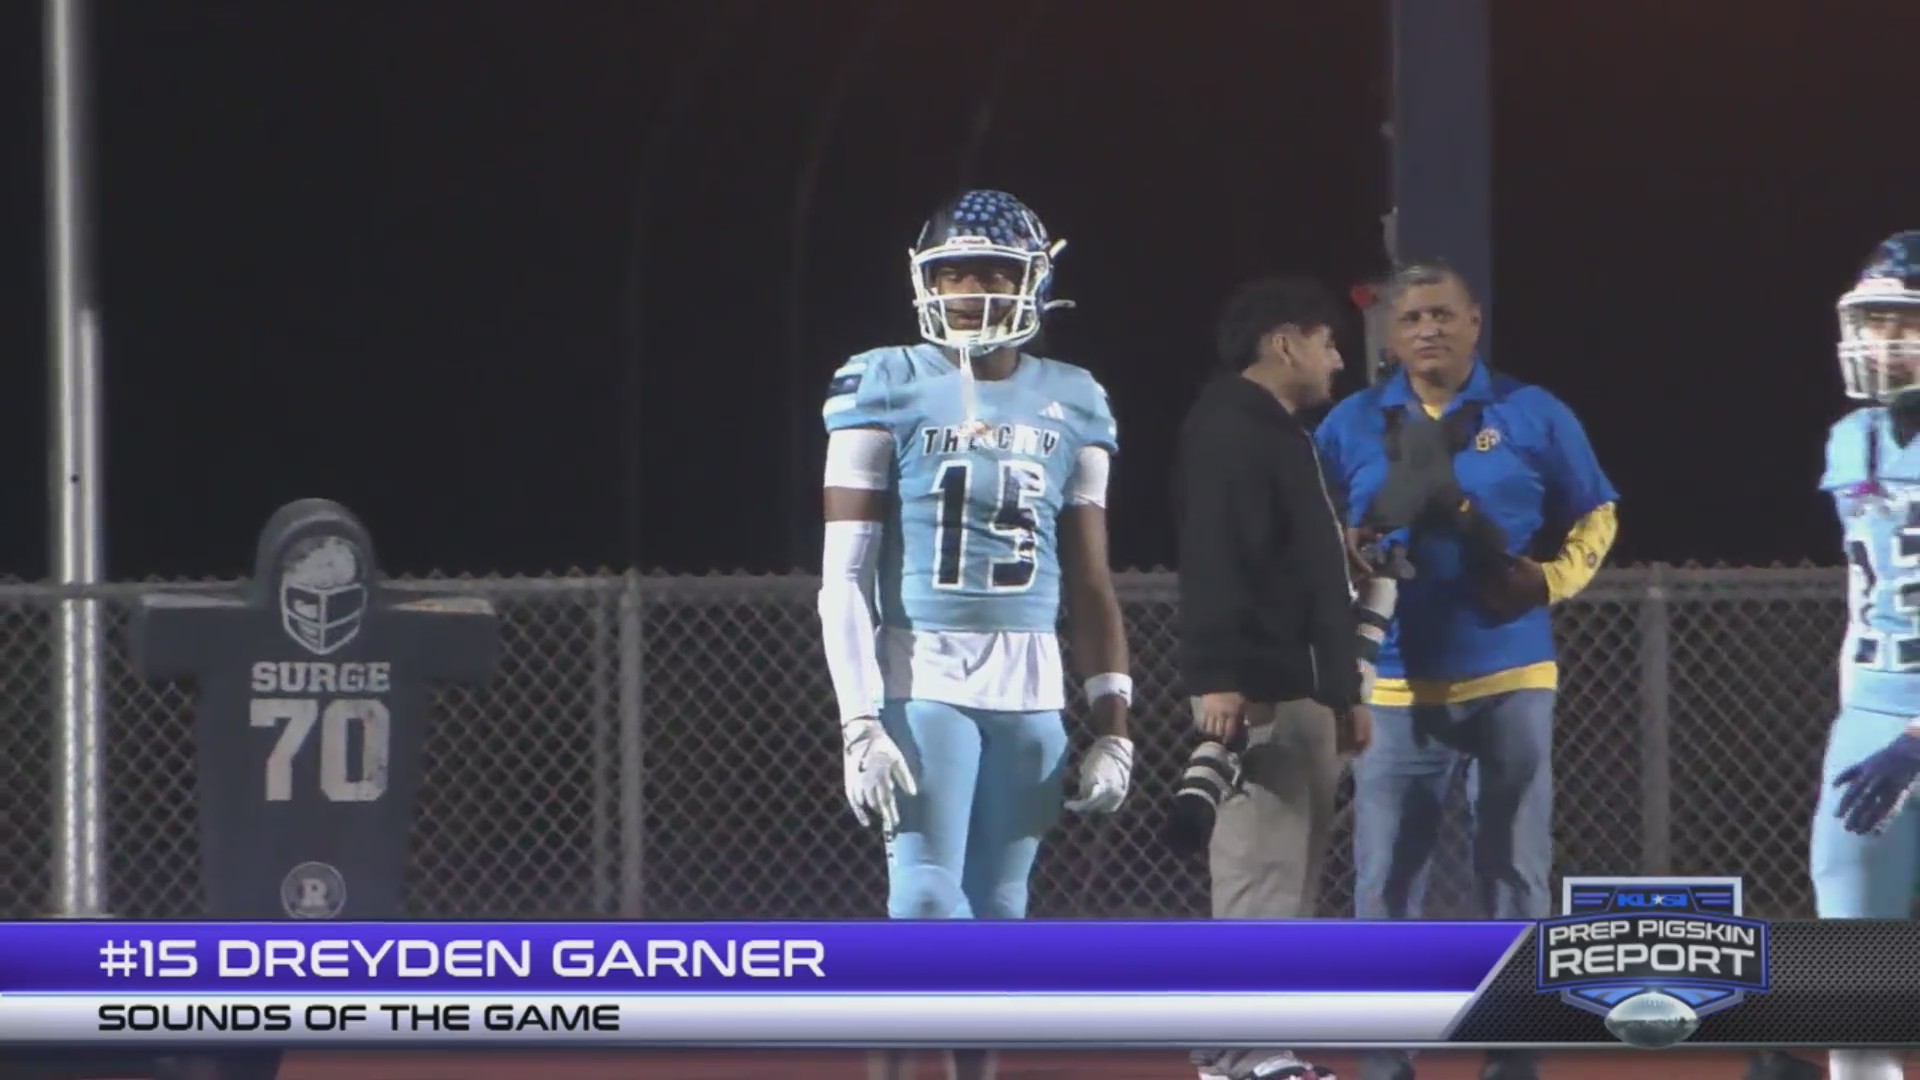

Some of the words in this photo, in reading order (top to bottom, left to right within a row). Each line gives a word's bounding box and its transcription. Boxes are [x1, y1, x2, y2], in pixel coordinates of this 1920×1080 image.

[931, 459, 1046, 592] 15
[251, 661, 391, 692] SURGE
[249, 699, 391, 802] 70
[301, 879, 328, 907] R
